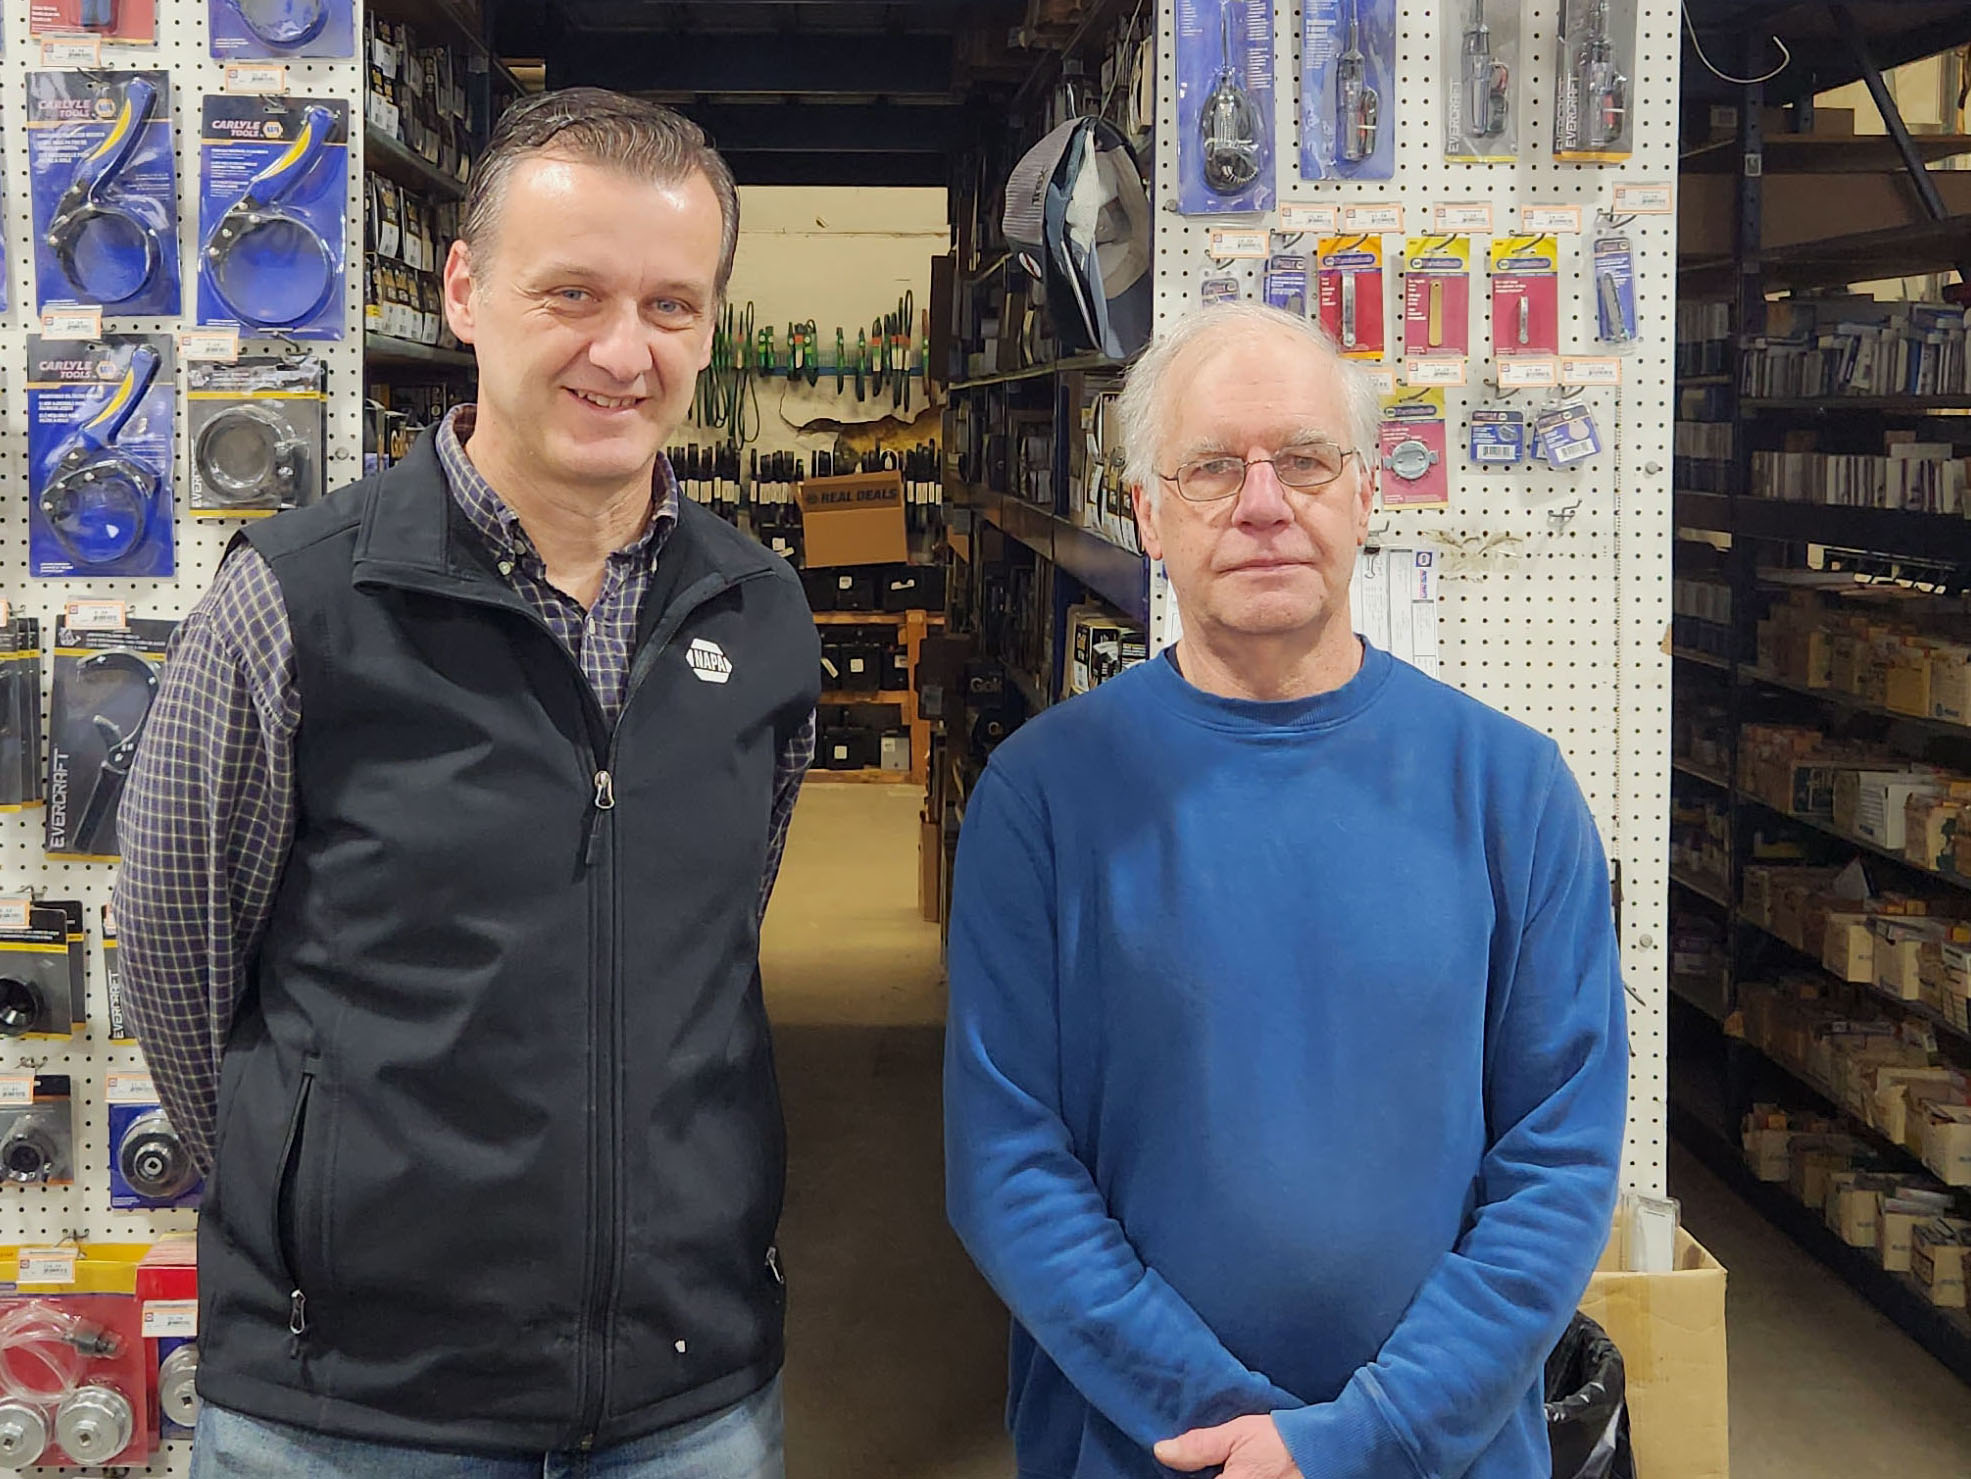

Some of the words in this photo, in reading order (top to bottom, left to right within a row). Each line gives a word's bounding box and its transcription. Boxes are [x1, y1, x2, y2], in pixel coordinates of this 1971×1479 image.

[1566, 73, 1579, 148] EVERCRAFT
[212, 120, 261, 130] CARLYLE
[231, 129, 260, 137] TOOLS
[39, 361, 92, 371] CARLYLE
[61, 371, 90, 379] TOOLS
[821, 491, 852, 503] REAL
[857, 488, 897, 501] DEALS
[694, 648, 727, 672] NAPA
[50, 748, 69, 849] EVERCRAFT
